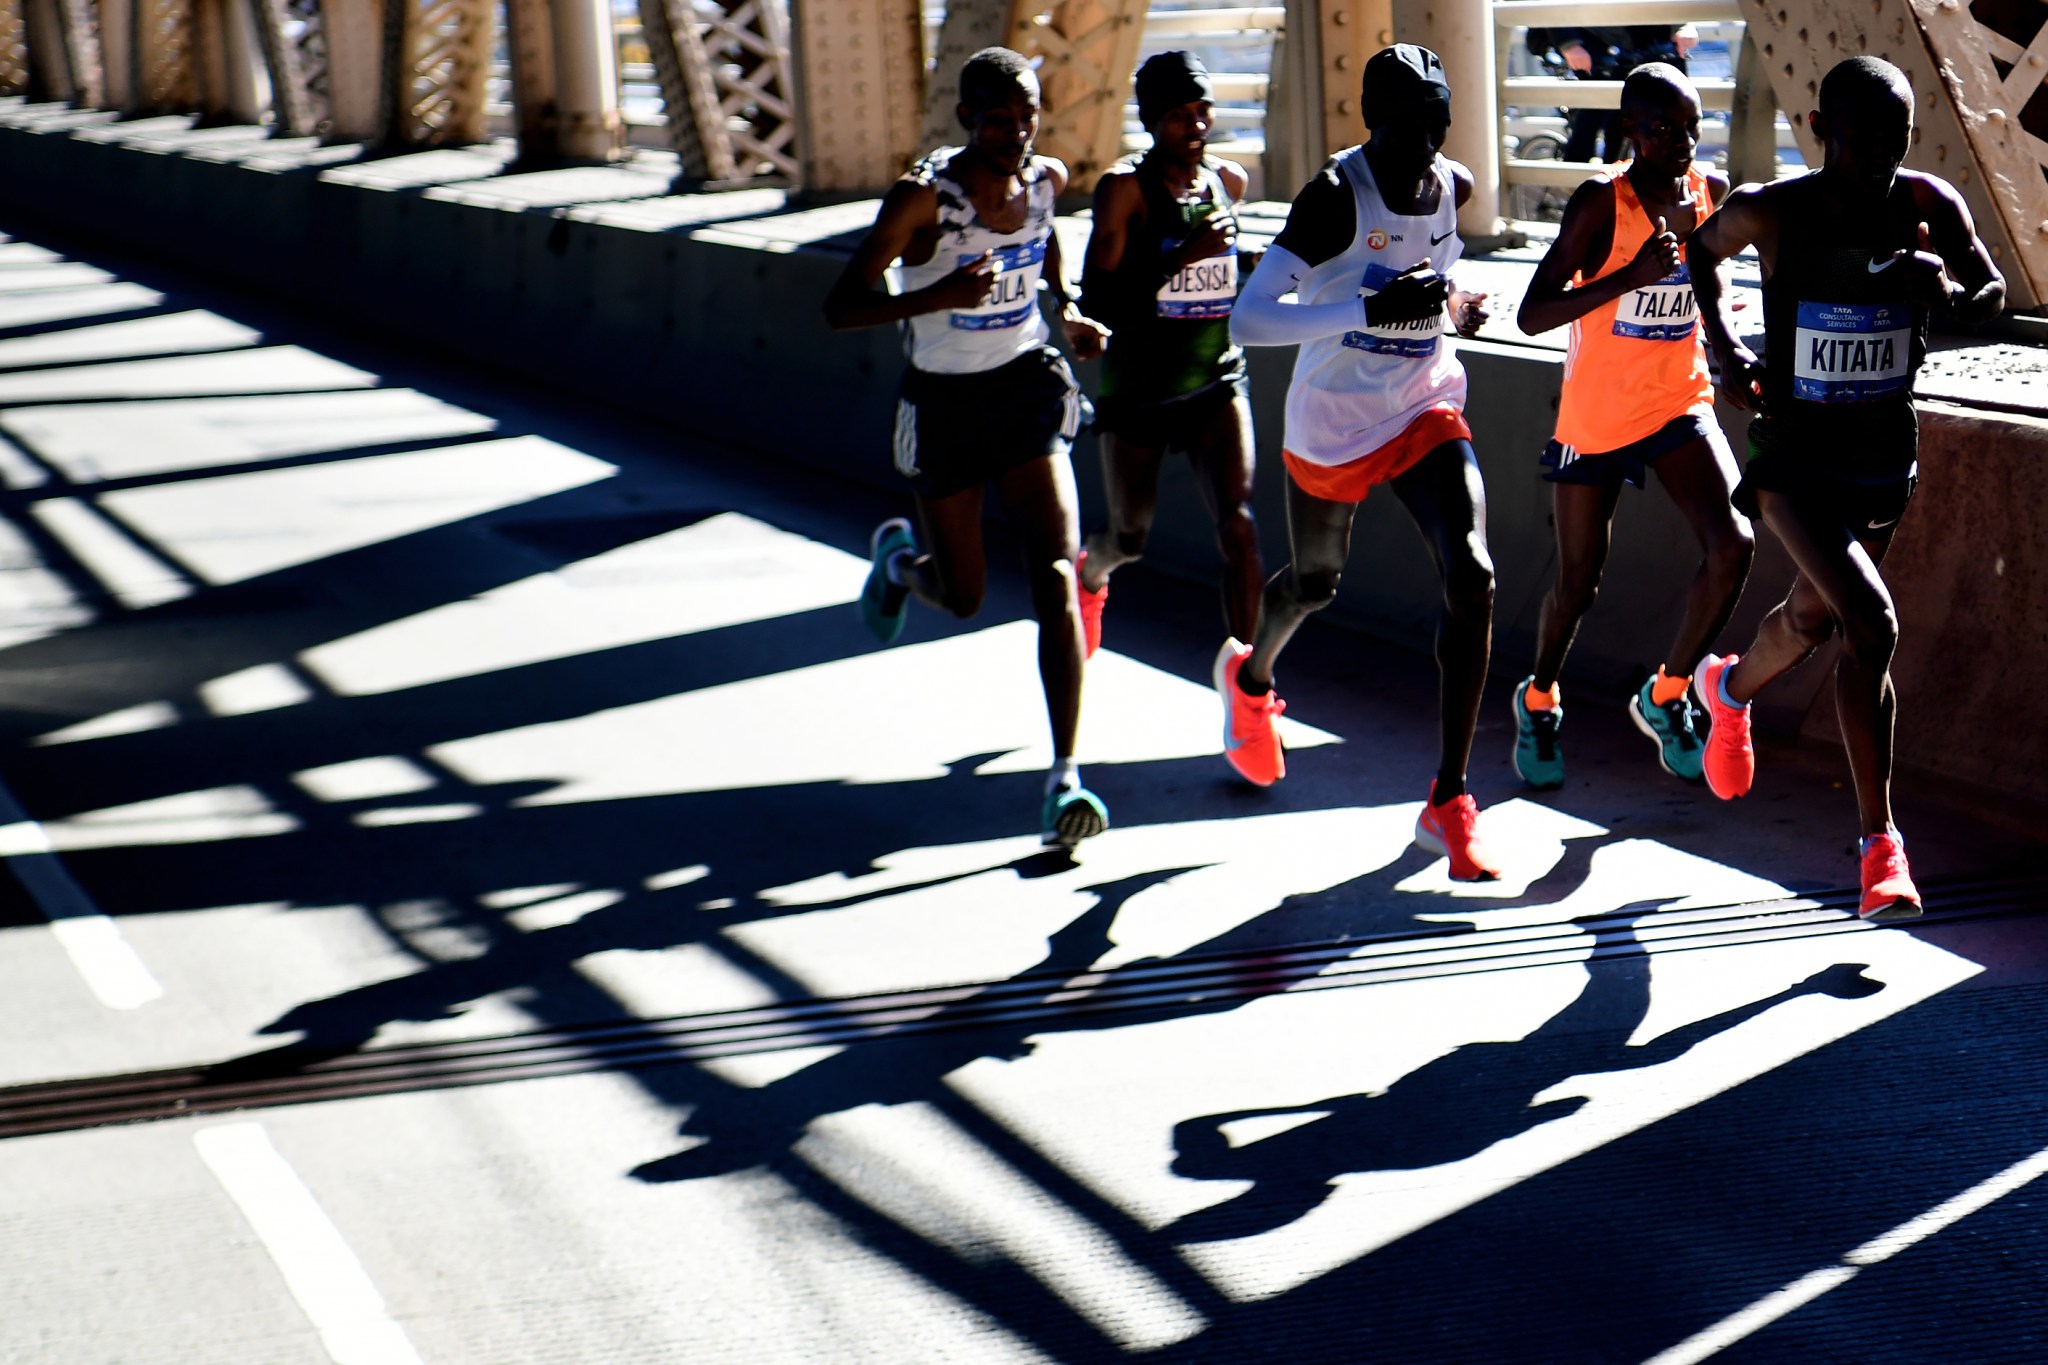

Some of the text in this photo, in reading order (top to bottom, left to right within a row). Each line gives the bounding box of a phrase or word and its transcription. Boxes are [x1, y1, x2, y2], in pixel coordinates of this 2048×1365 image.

[1390, 234, 1404, 242] NN
[990, 274, 1027, 305] OLA
[1170, 264, 1231, 293] DESISA
[1819, 313, 1865, 321] CONSULTANCY
[1810, 337, 1894, 373] KITATA
